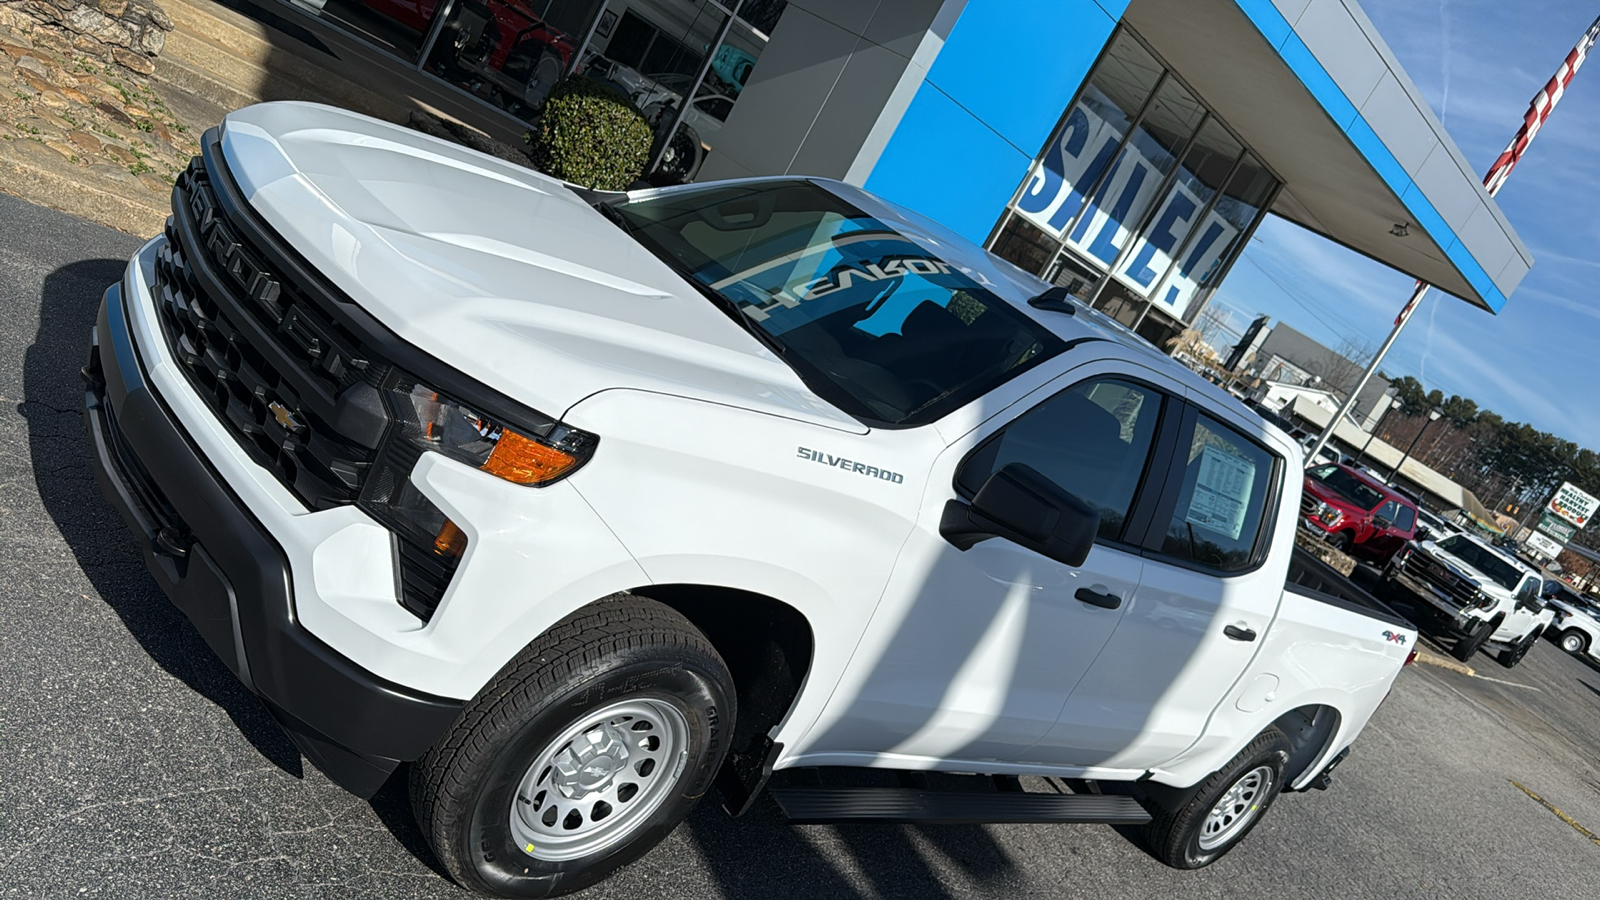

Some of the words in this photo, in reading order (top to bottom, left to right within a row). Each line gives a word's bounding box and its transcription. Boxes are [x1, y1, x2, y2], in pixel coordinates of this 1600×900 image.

[1016, 105, 1225, 307] SALE!
[796, 446, 904, 485] SILVERADO
[1559, 494, 1590, 513] HARVEST
[1560, 487, 1589, 507] HEALTHY
[1558, 501, 1589, 521] PRODUCE
